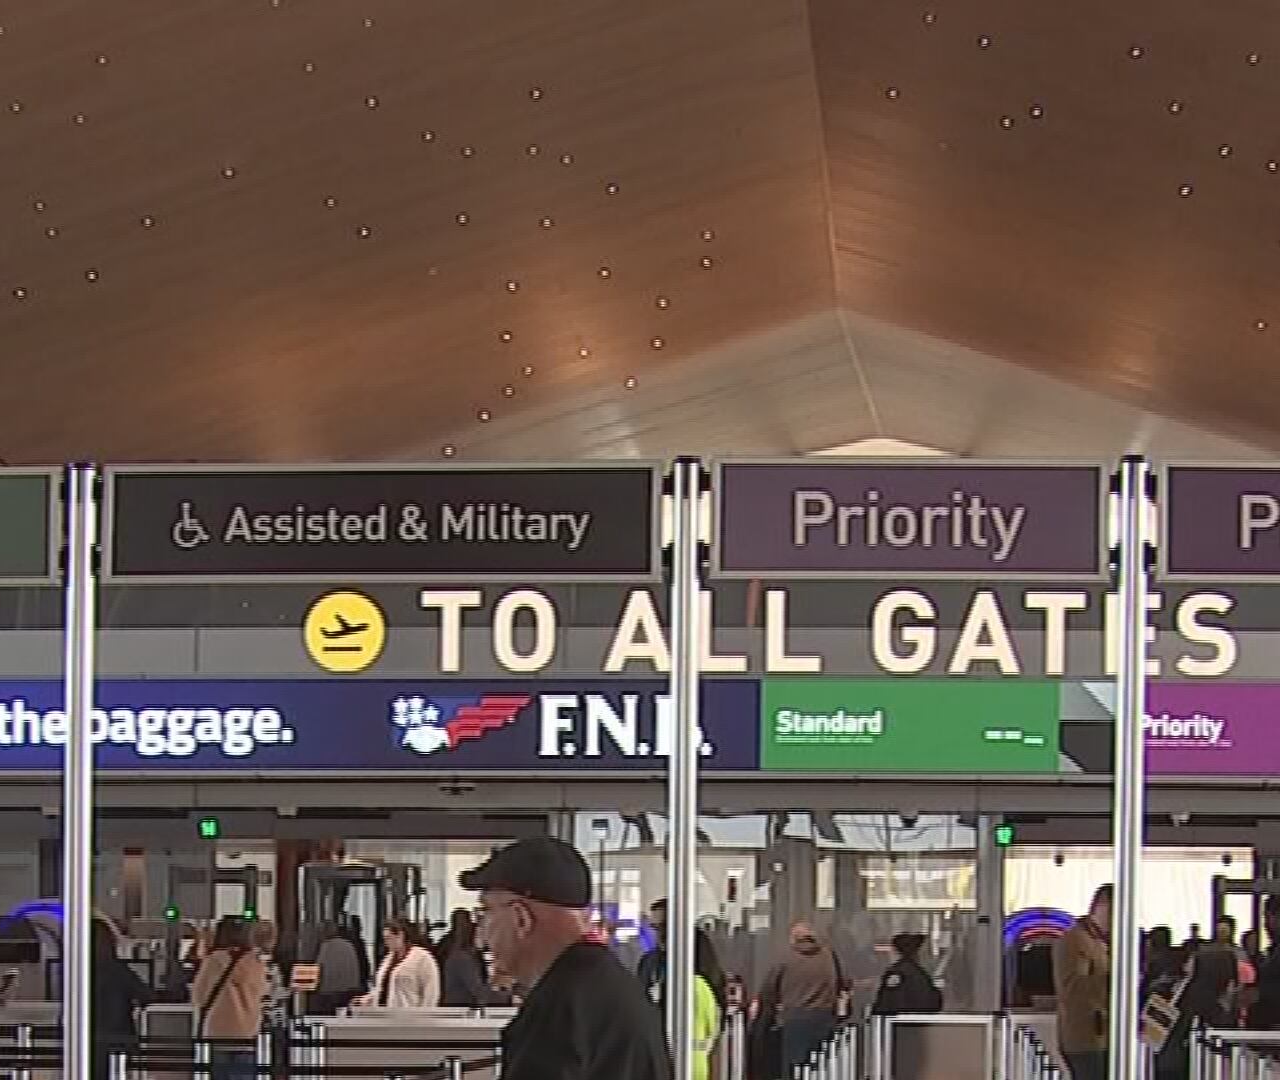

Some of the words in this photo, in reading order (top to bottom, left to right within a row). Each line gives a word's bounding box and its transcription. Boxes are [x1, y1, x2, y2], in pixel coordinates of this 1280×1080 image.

[224, 503, 386, 543] Assisted
[398, 503, 429, 543] &
[441, 502, 590, 551] Military
[794, 490, 1025, 562] Priority
[421, 589, 557, 672] TO
[604, 590, 822, 673] ALL
[873, 590, 1238, 676] GATES
[776, 710, 882, 735] Standard
